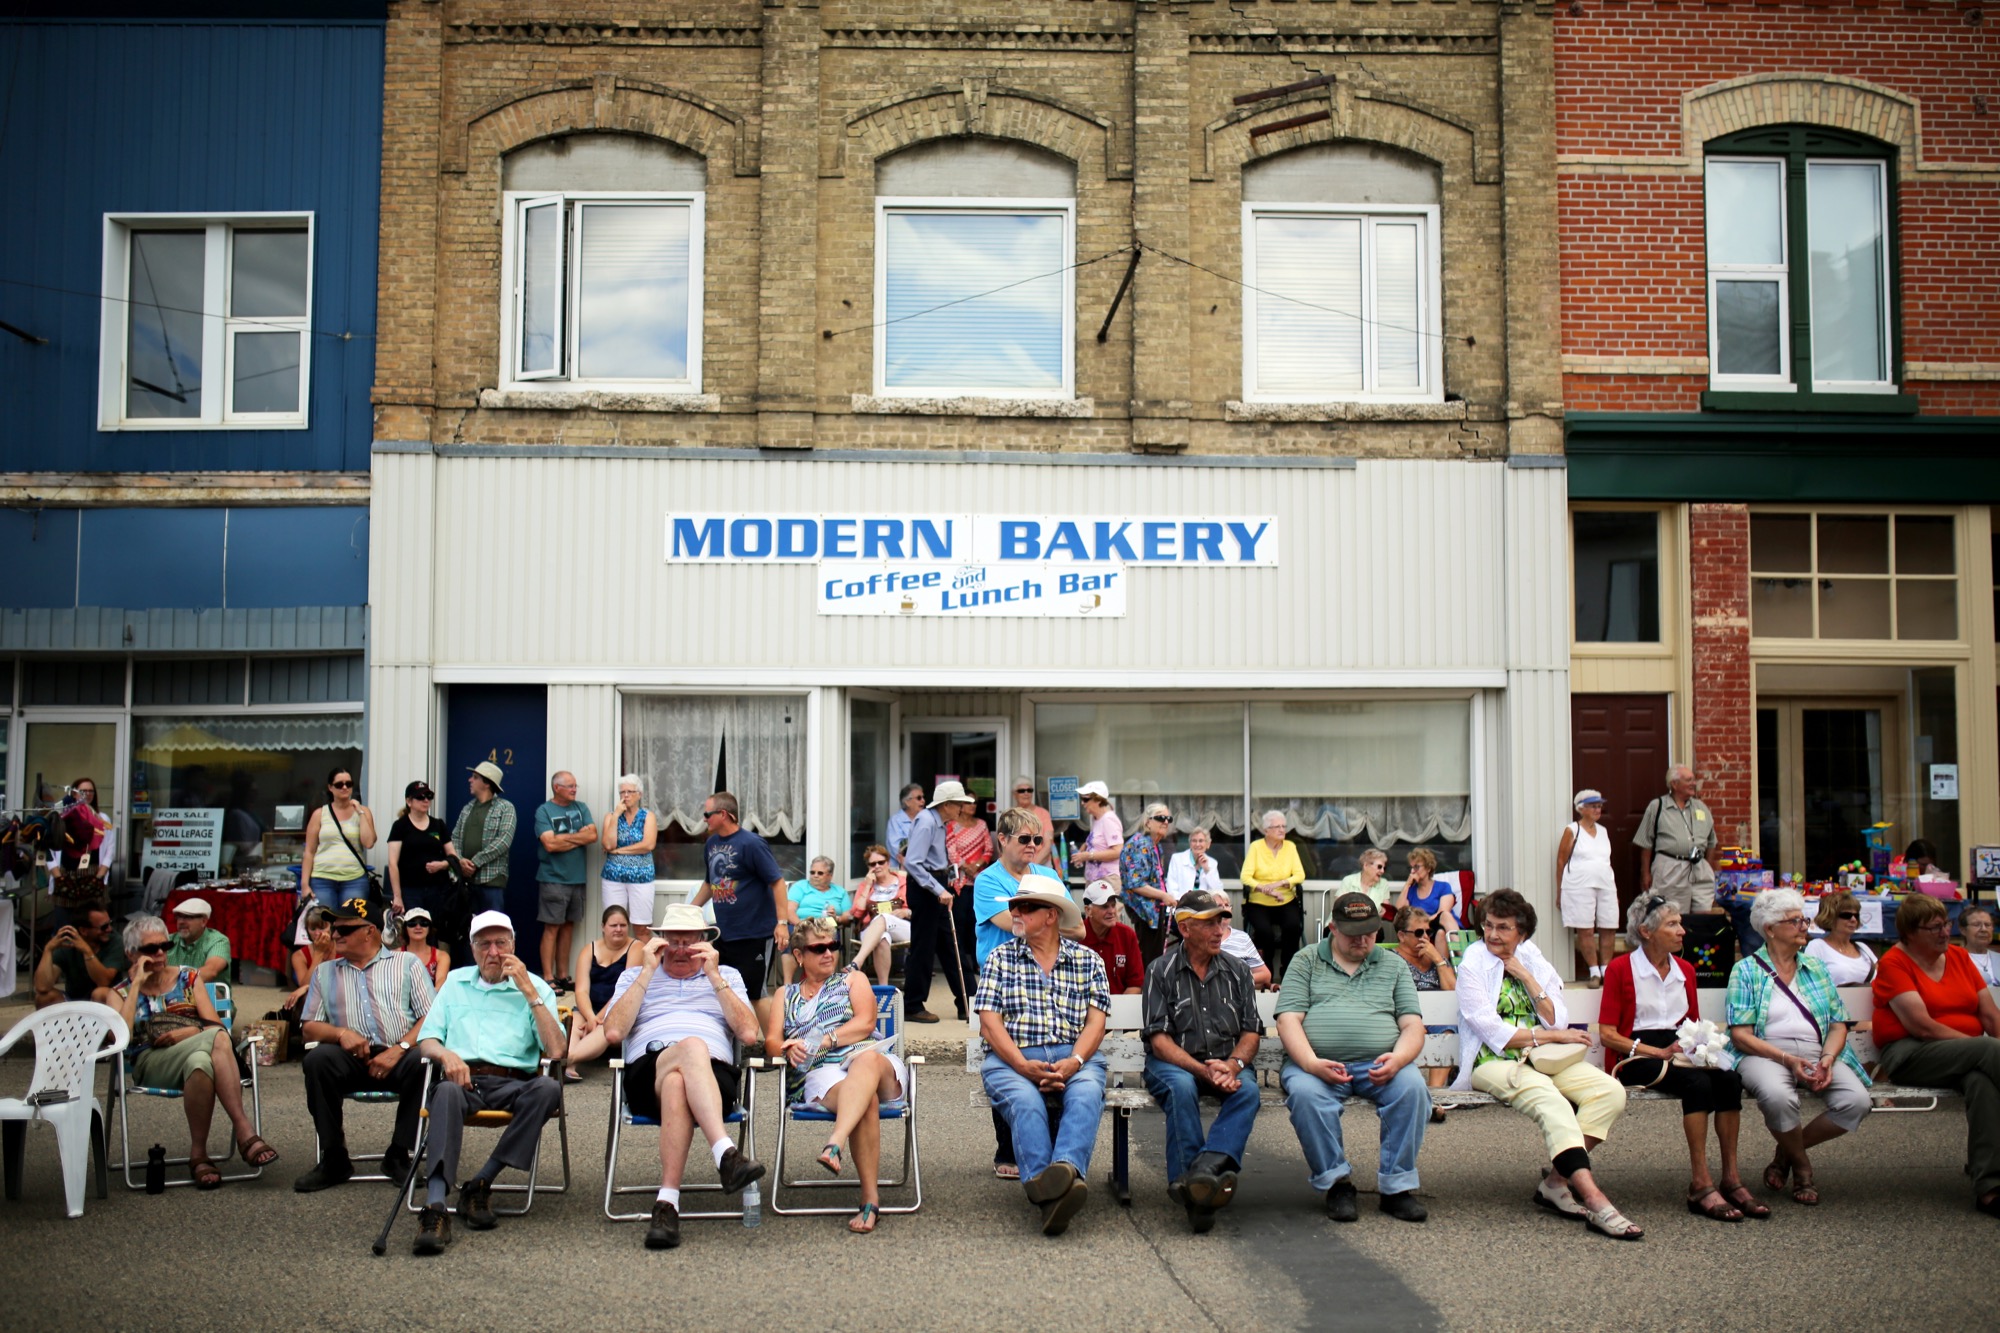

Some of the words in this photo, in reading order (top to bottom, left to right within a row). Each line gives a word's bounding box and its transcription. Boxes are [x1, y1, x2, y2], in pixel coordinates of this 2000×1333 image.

[671, 518, 953, 560] MODERN
[998, 520, 1269, 562] BAKERY
[825, 571, 941, 600] Coffee
[951, 565, 986, 591] and
[1059, 572, 1118, 595] Bar
[941, 579, 1042, 611] Lunch
[1051, 784, 1076, 792] CLOSED
[152, 829, 179, 838] ROYAL
[179, 849, 211, 857] AGENCIES
